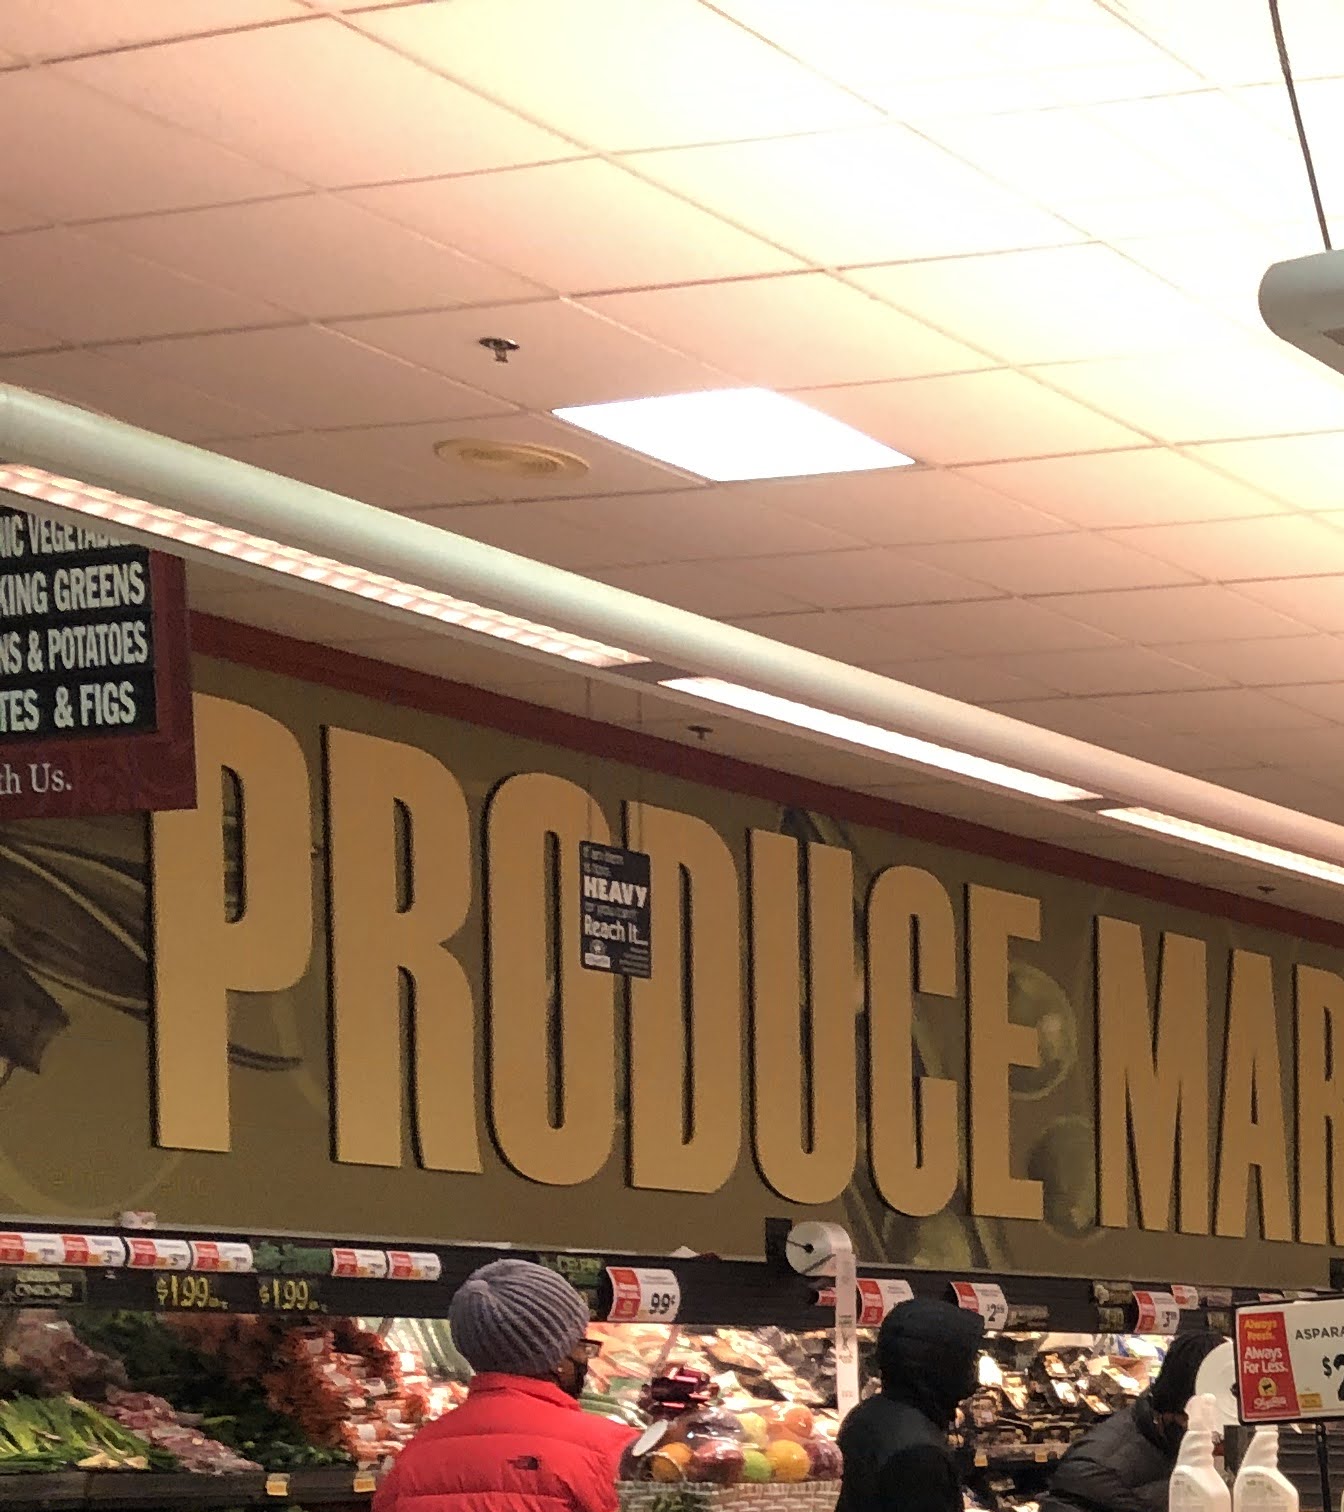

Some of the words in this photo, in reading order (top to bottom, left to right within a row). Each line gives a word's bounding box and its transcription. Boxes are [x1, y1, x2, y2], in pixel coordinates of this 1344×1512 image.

[53, 560, 146, 613] GREENS
[27, 630, 43, 672] &
[48, 620, 148, 671] POTATOES
[54, 686, 74, 729] &
[80, 680, 137, 726] FIGS
[29, 763, 72, 792] Us.
[583, 875, 647, 908] HEAVY
[151, 691, 1045, 1222] PRODUCE
[1245, 1346, 1282, 1361] Always
